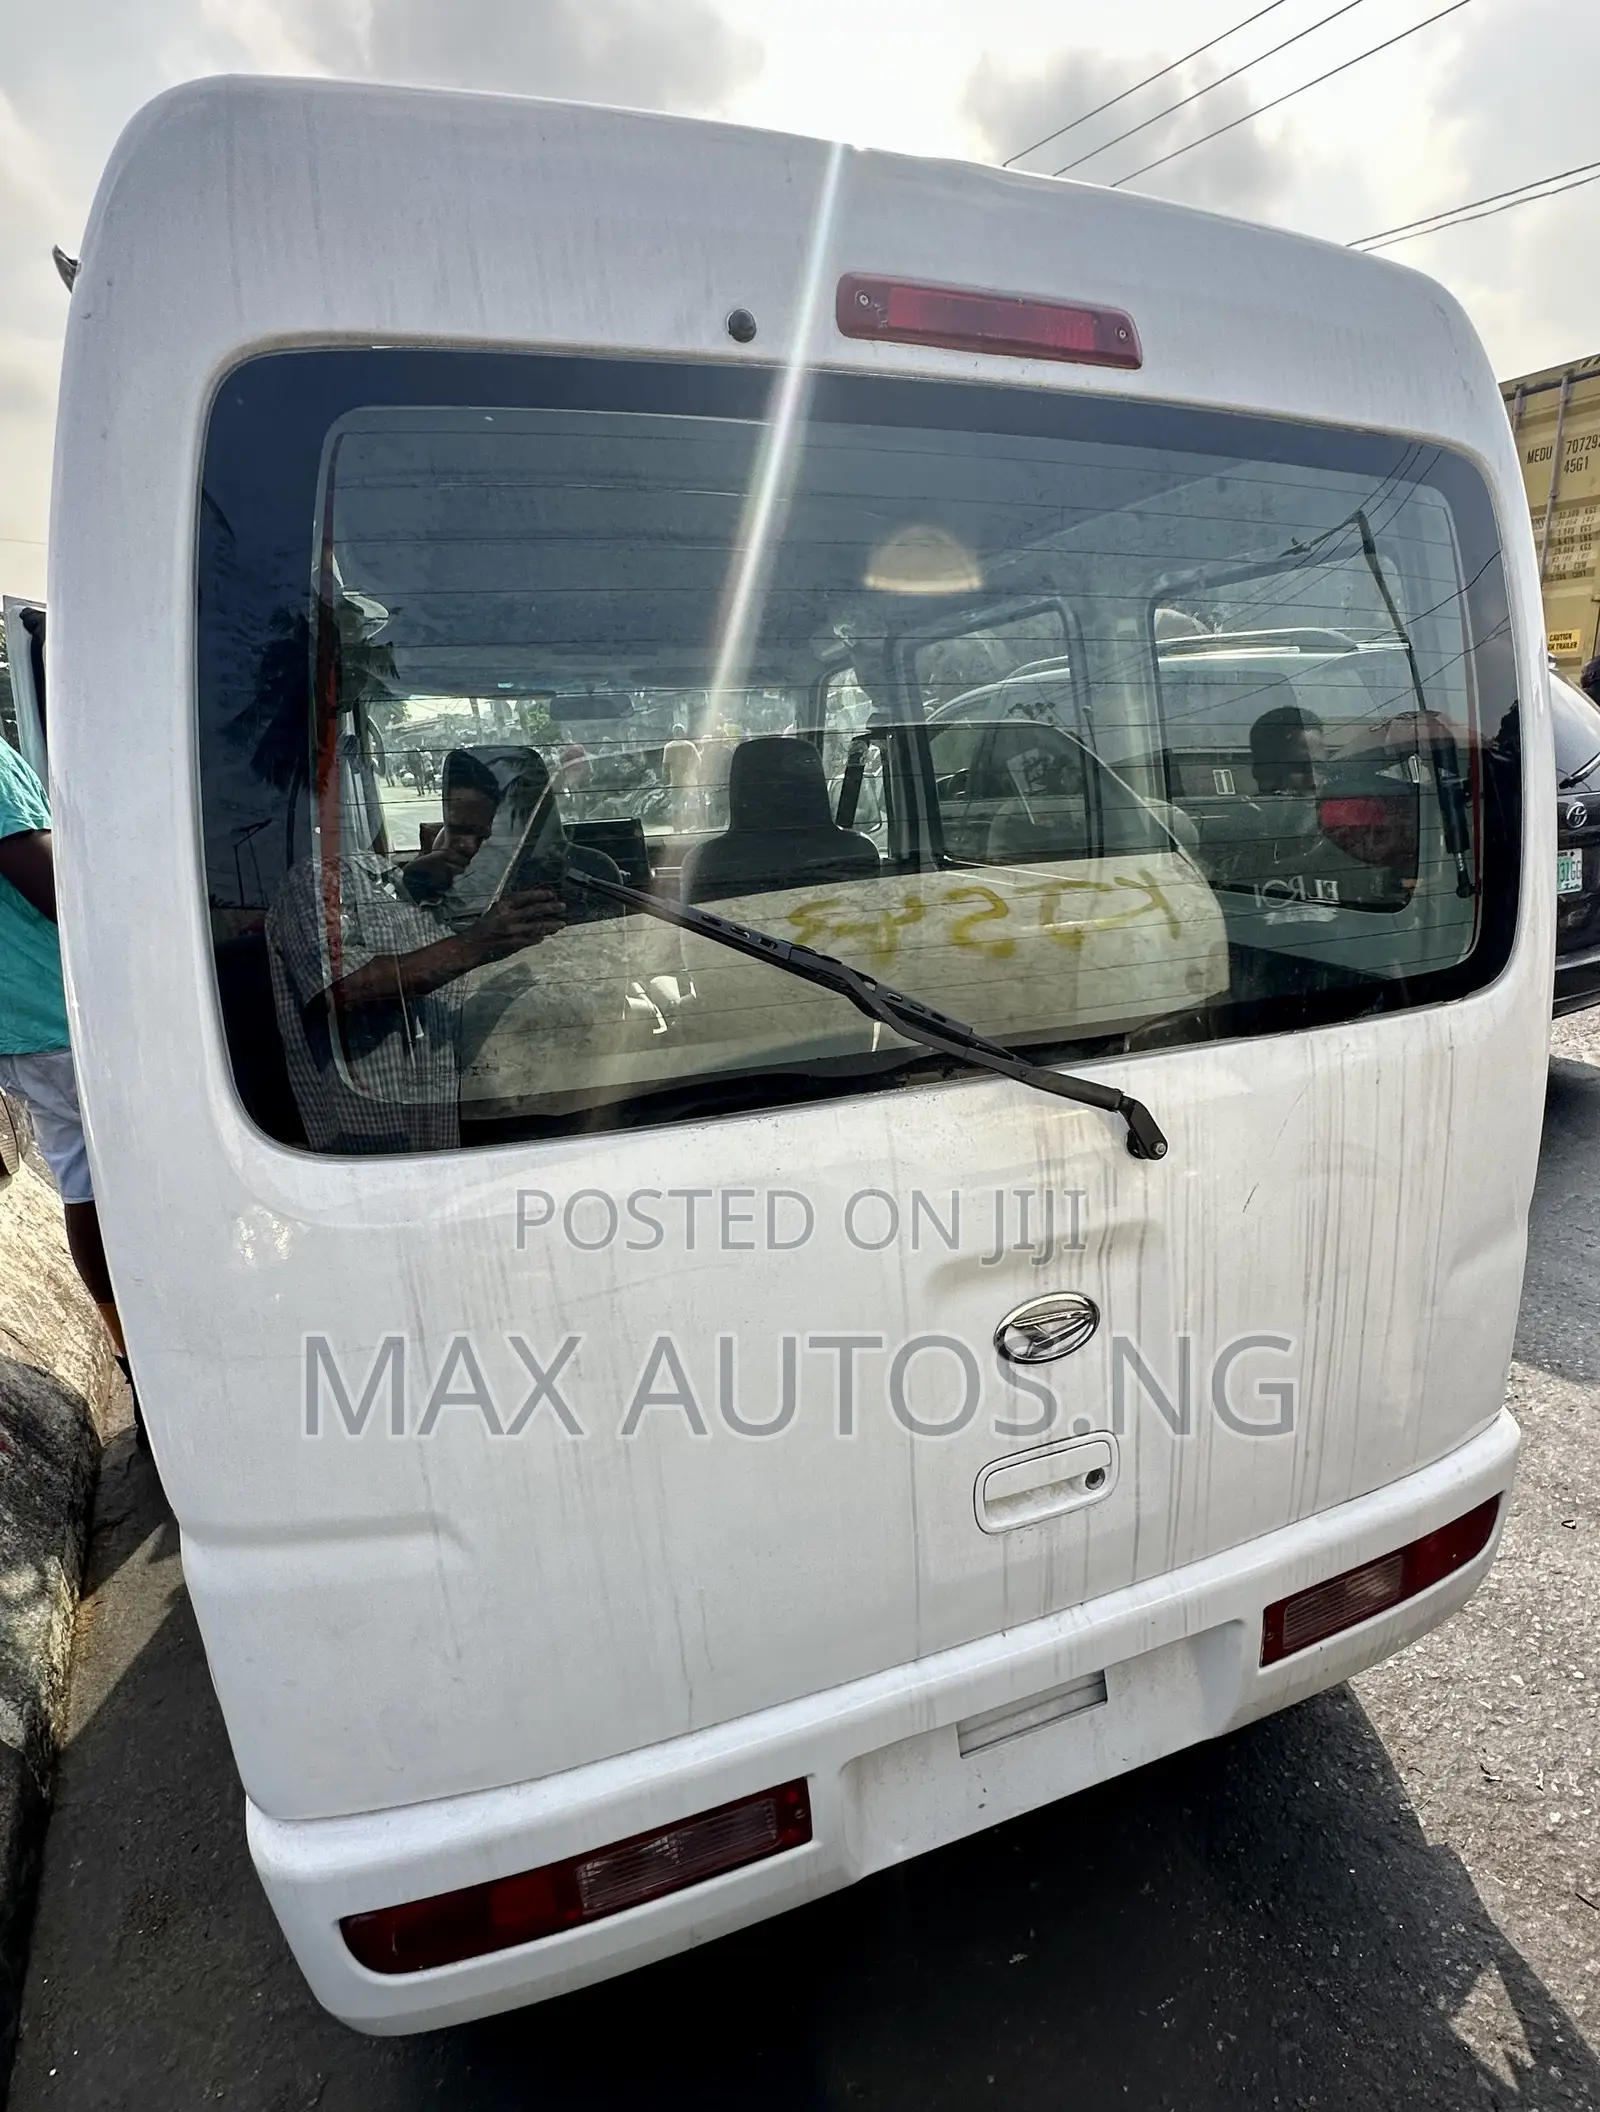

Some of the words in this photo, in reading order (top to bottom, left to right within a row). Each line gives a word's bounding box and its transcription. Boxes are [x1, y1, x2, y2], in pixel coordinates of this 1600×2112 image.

[1527, 445, 1553, 464] MEDU
[1564, 455, 1589, 474] 45G1
[1556, 642, 1577, 650] TRAILER
